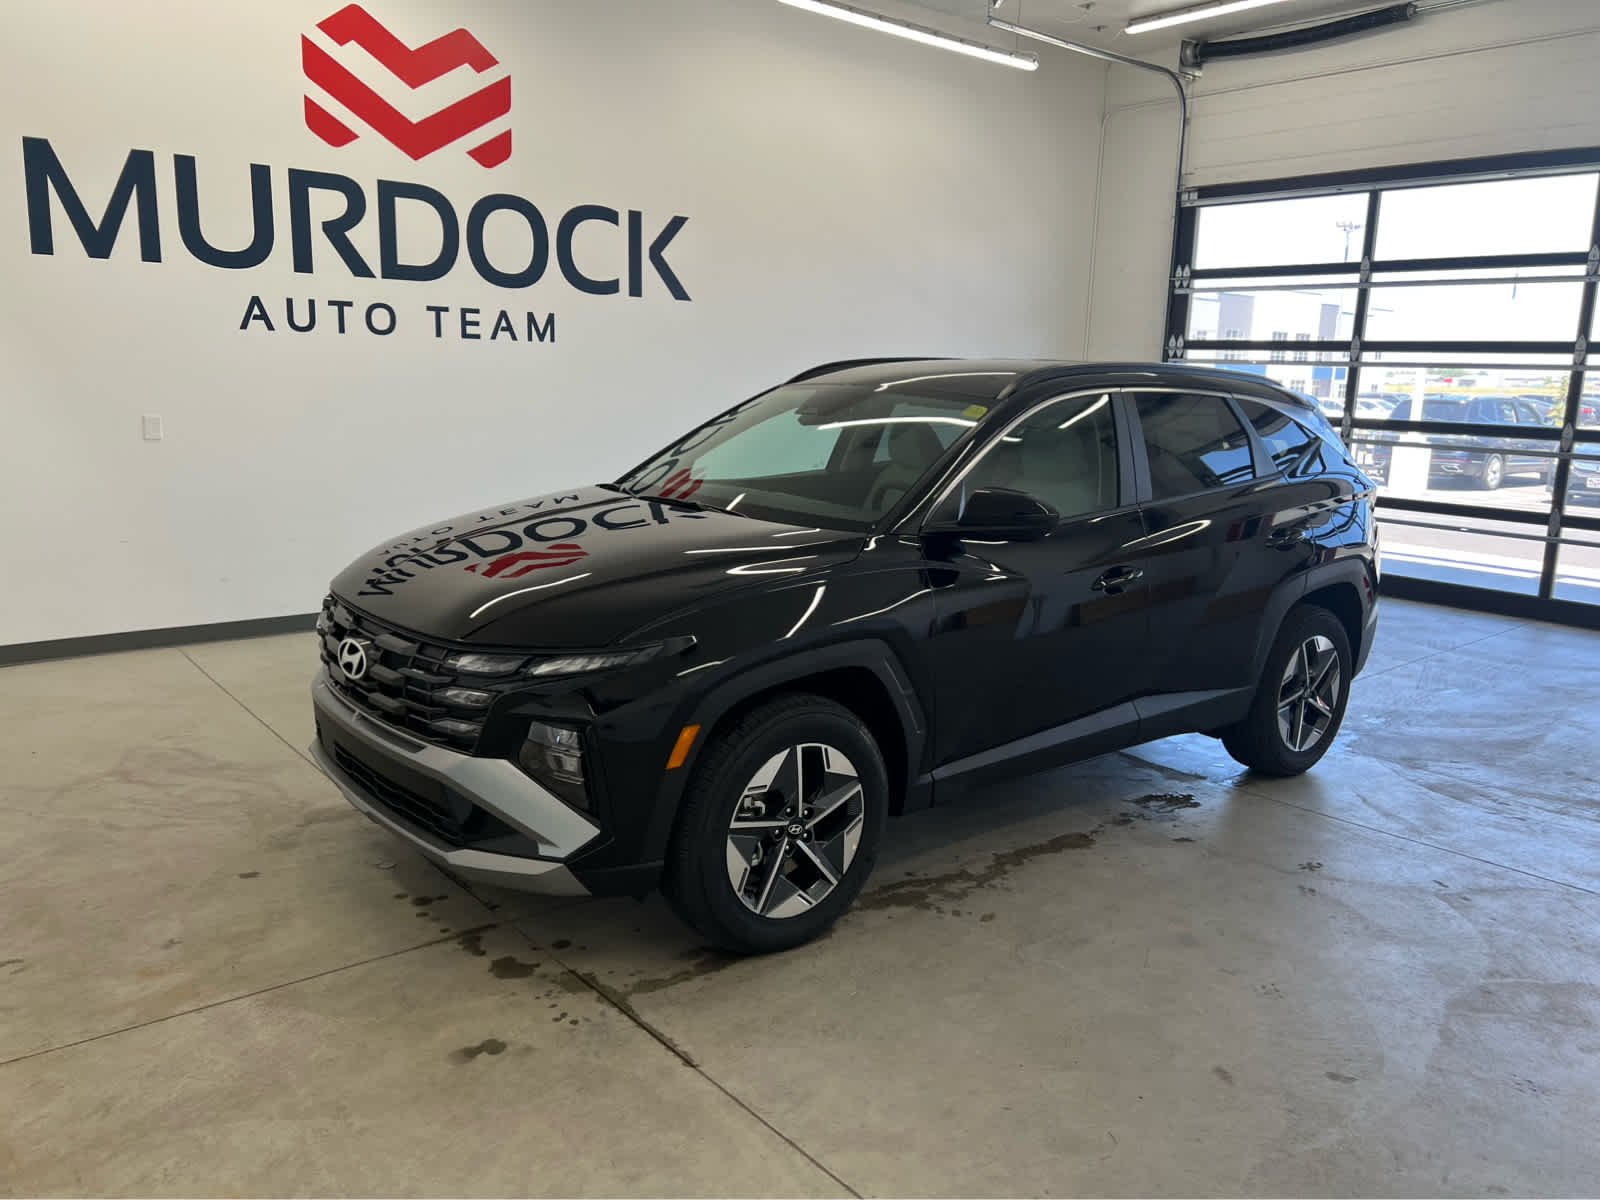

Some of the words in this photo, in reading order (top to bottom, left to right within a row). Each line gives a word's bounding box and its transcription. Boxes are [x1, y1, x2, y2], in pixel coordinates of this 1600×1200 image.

[22, 136, 692, 302] MURDOCK
[239, 295, 397, 336] AUTO
[426, 305, 556, 343] TEAM
